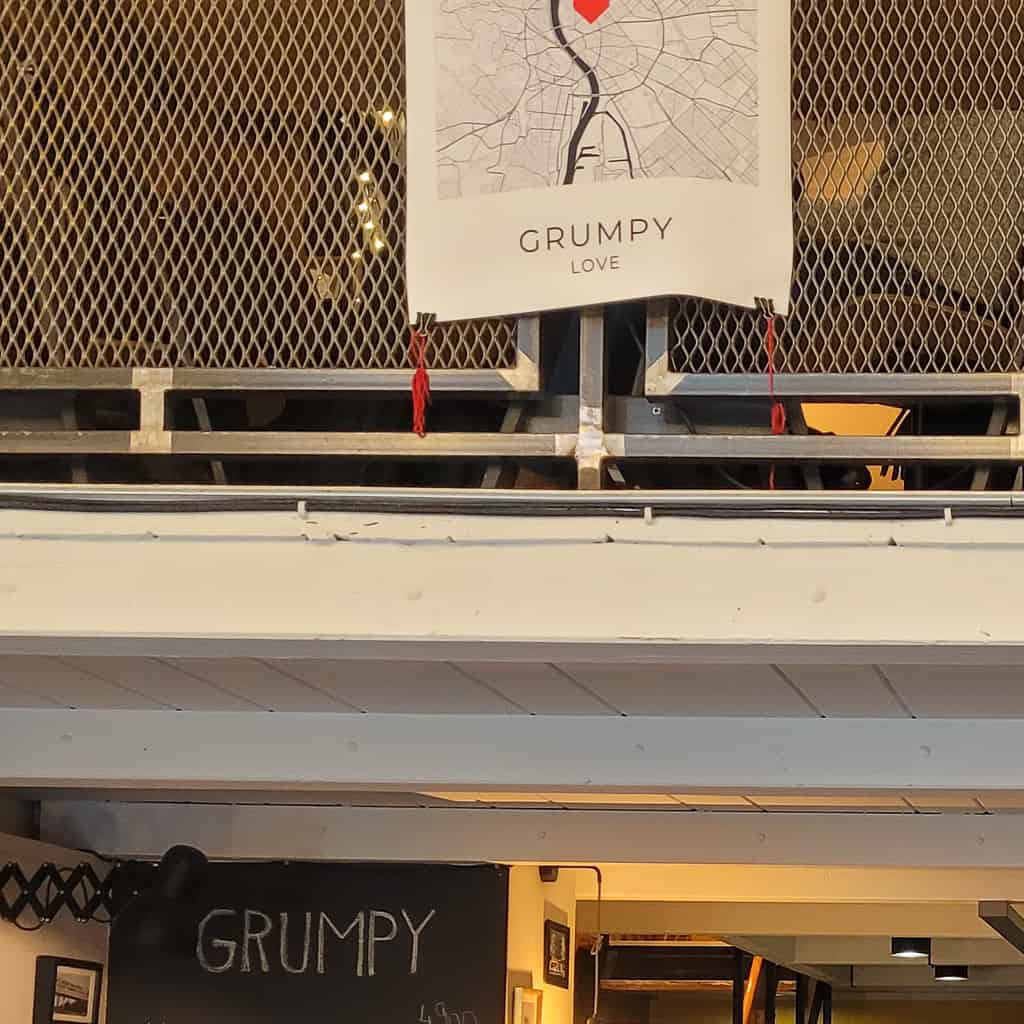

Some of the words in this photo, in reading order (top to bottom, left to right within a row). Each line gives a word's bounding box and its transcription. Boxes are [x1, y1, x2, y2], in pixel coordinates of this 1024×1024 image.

[519, 217, 673, 253] GRUMPY
[570, 255, 622, 275] LOVE
[196, 908, 436, 977] GRUMPY
